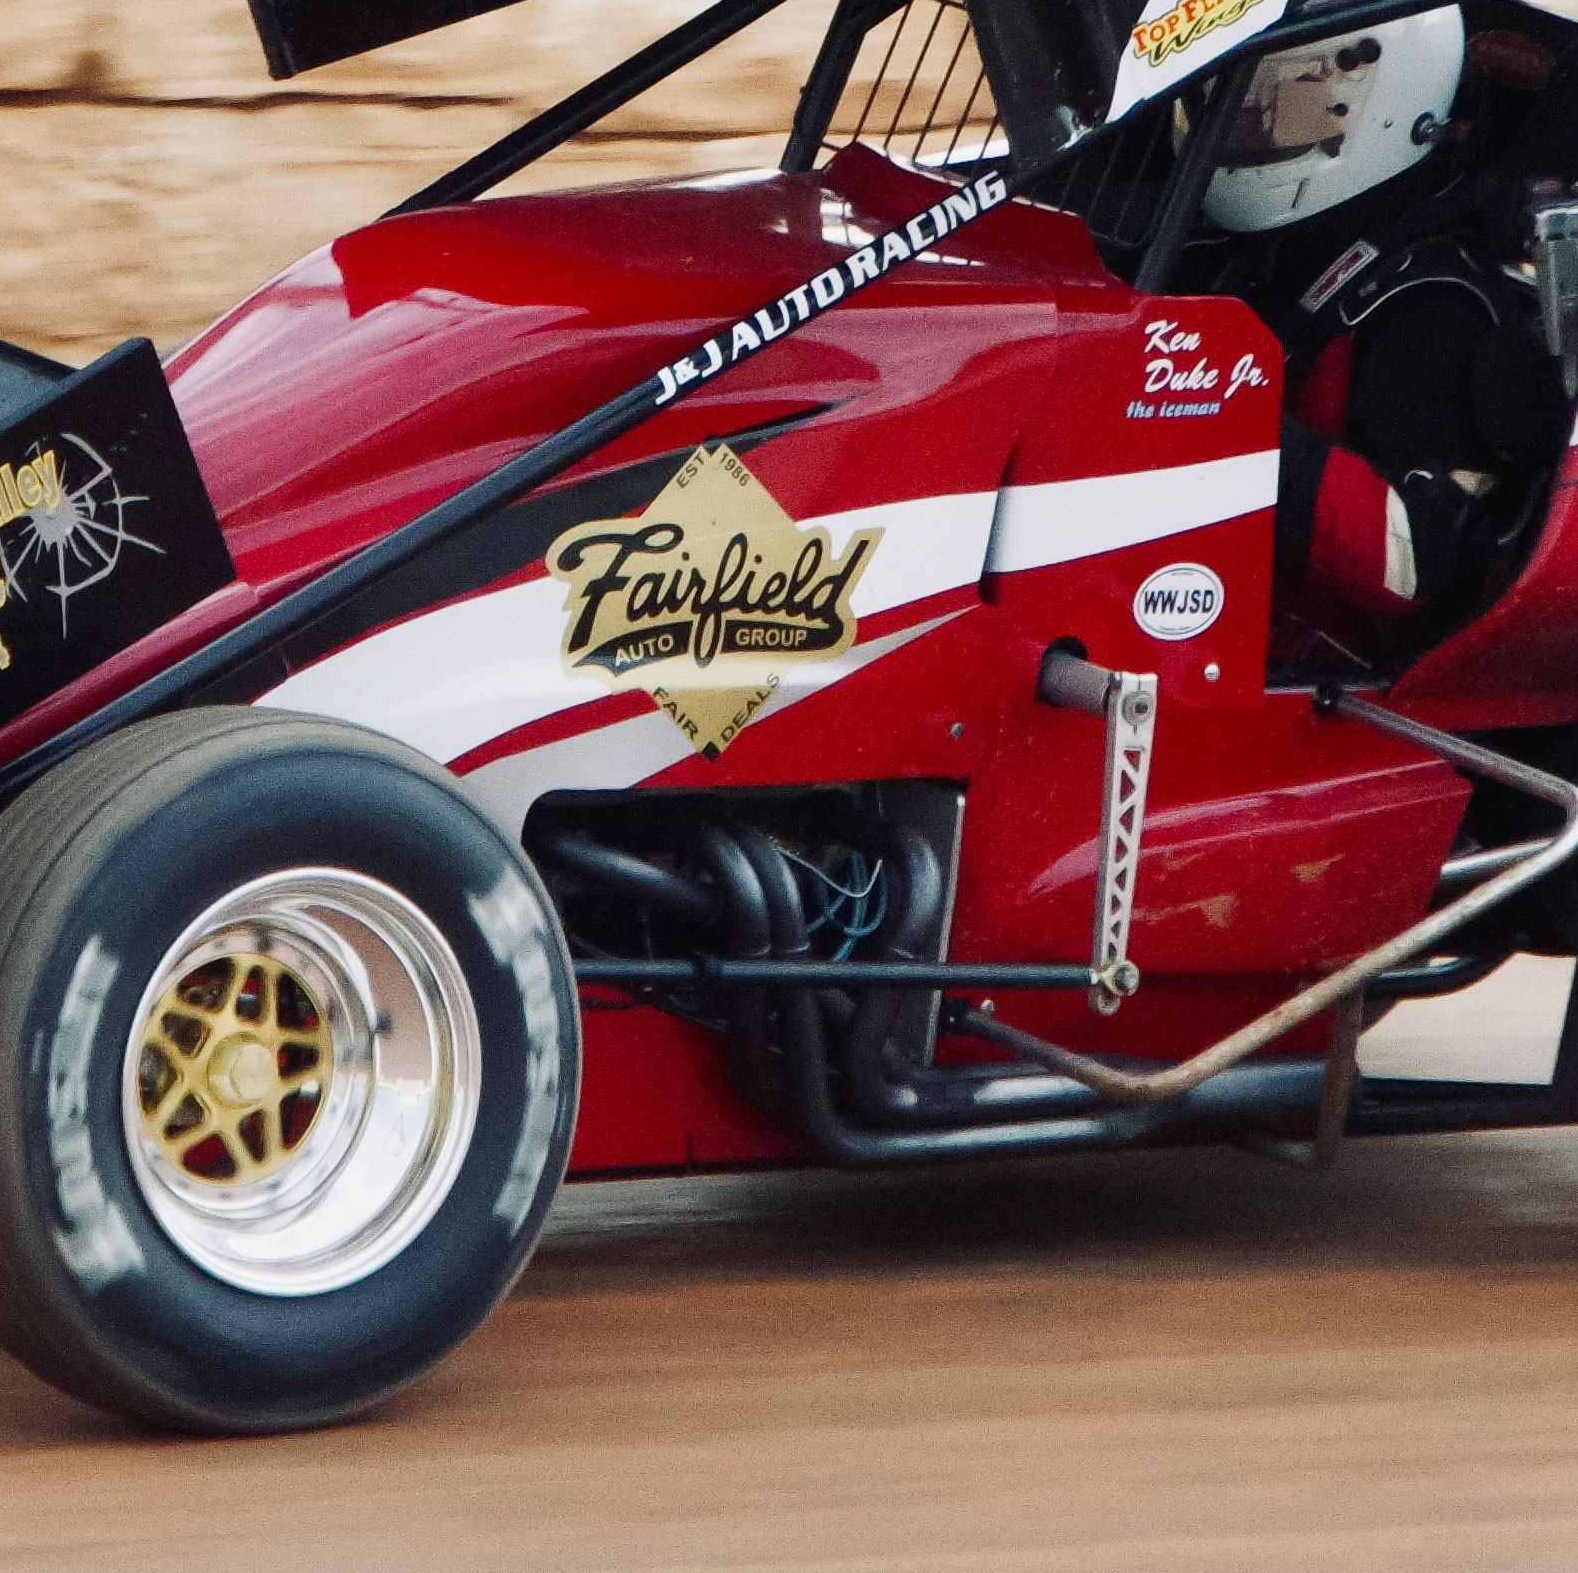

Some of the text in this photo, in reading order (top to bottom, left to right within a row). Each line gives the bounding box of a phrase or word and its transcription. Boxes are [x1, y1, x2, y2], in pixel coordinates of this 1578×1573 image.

[1130, 14, 1180, 53] TOP
[655, 169, 1008, 406] J&J AUTO RACING
[1143, 319, 1202, 355] Ken
[1143, 352, 1270, 400] Duke Jr.
[1159, 399, 1222, 418] iceman
[676, 453, 706, 489] EST
[718, 452, 750, 487] 1986
[556, 523, 871, 669] Fairfield
[1144, 589, 1215, 614] WWJSD
[614, 627, 808, 667] AUTO GROUP
[652, 686, 700, 741] FAIR
[720, 672, 781, 744] DEALS
